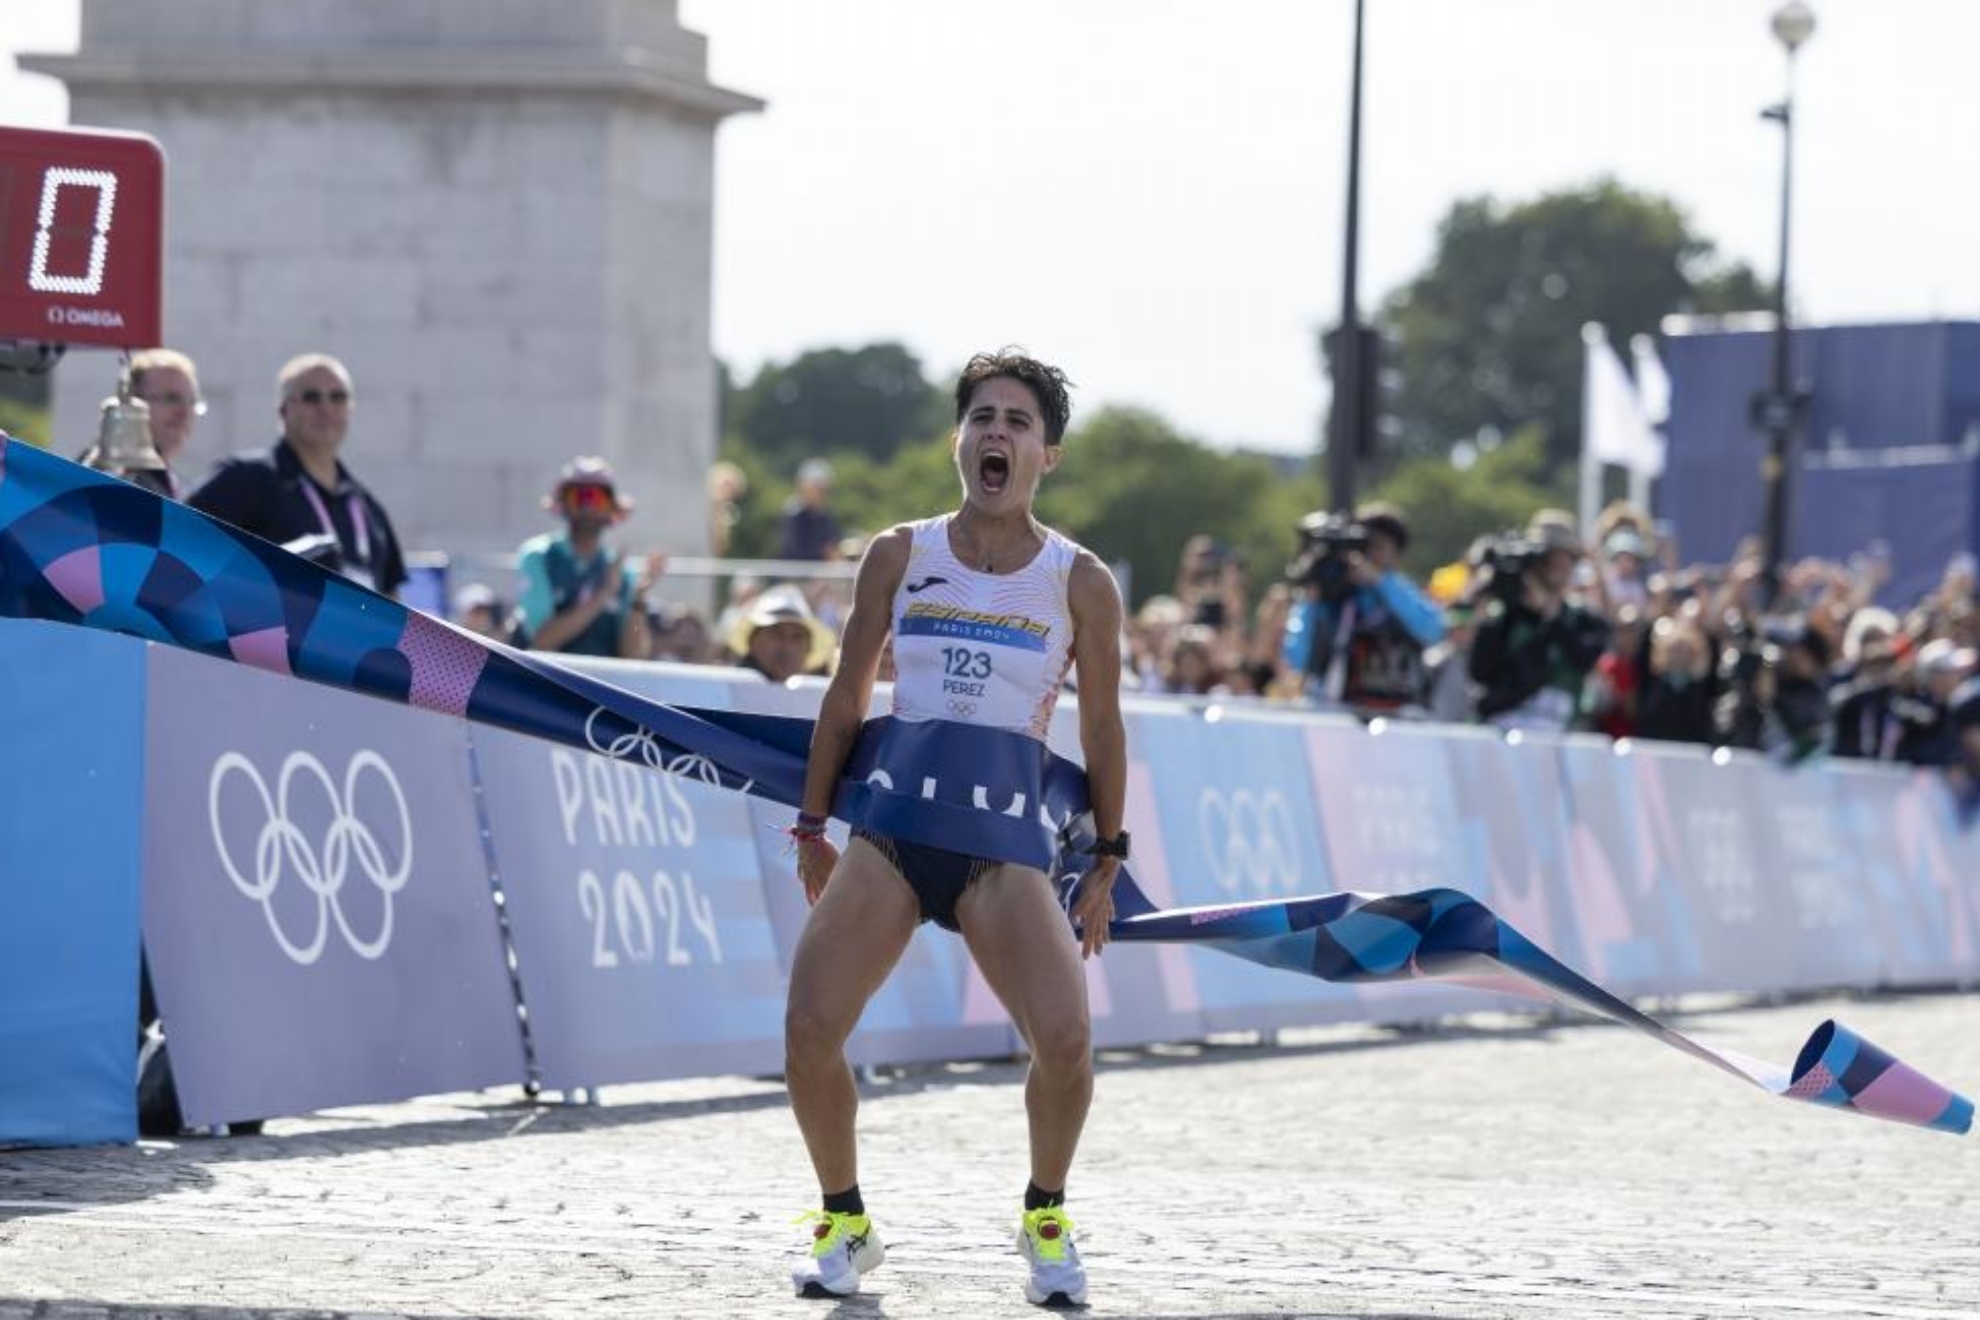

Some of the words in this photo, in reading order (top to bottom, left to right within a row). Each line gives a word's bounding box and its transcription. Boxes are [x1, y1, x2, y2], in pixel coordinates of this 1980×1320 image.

[28, 166, 118, 295] 0
[67, 309, 124, 328] OMEGA
[933, 622, 972, 635] PARIS
[941, 647, 993, 679] 123
[942, 679, 986, 697] PEREZ
[552, 749, 696, 847] PARIS
[578, 869, 724, 968] 2024
